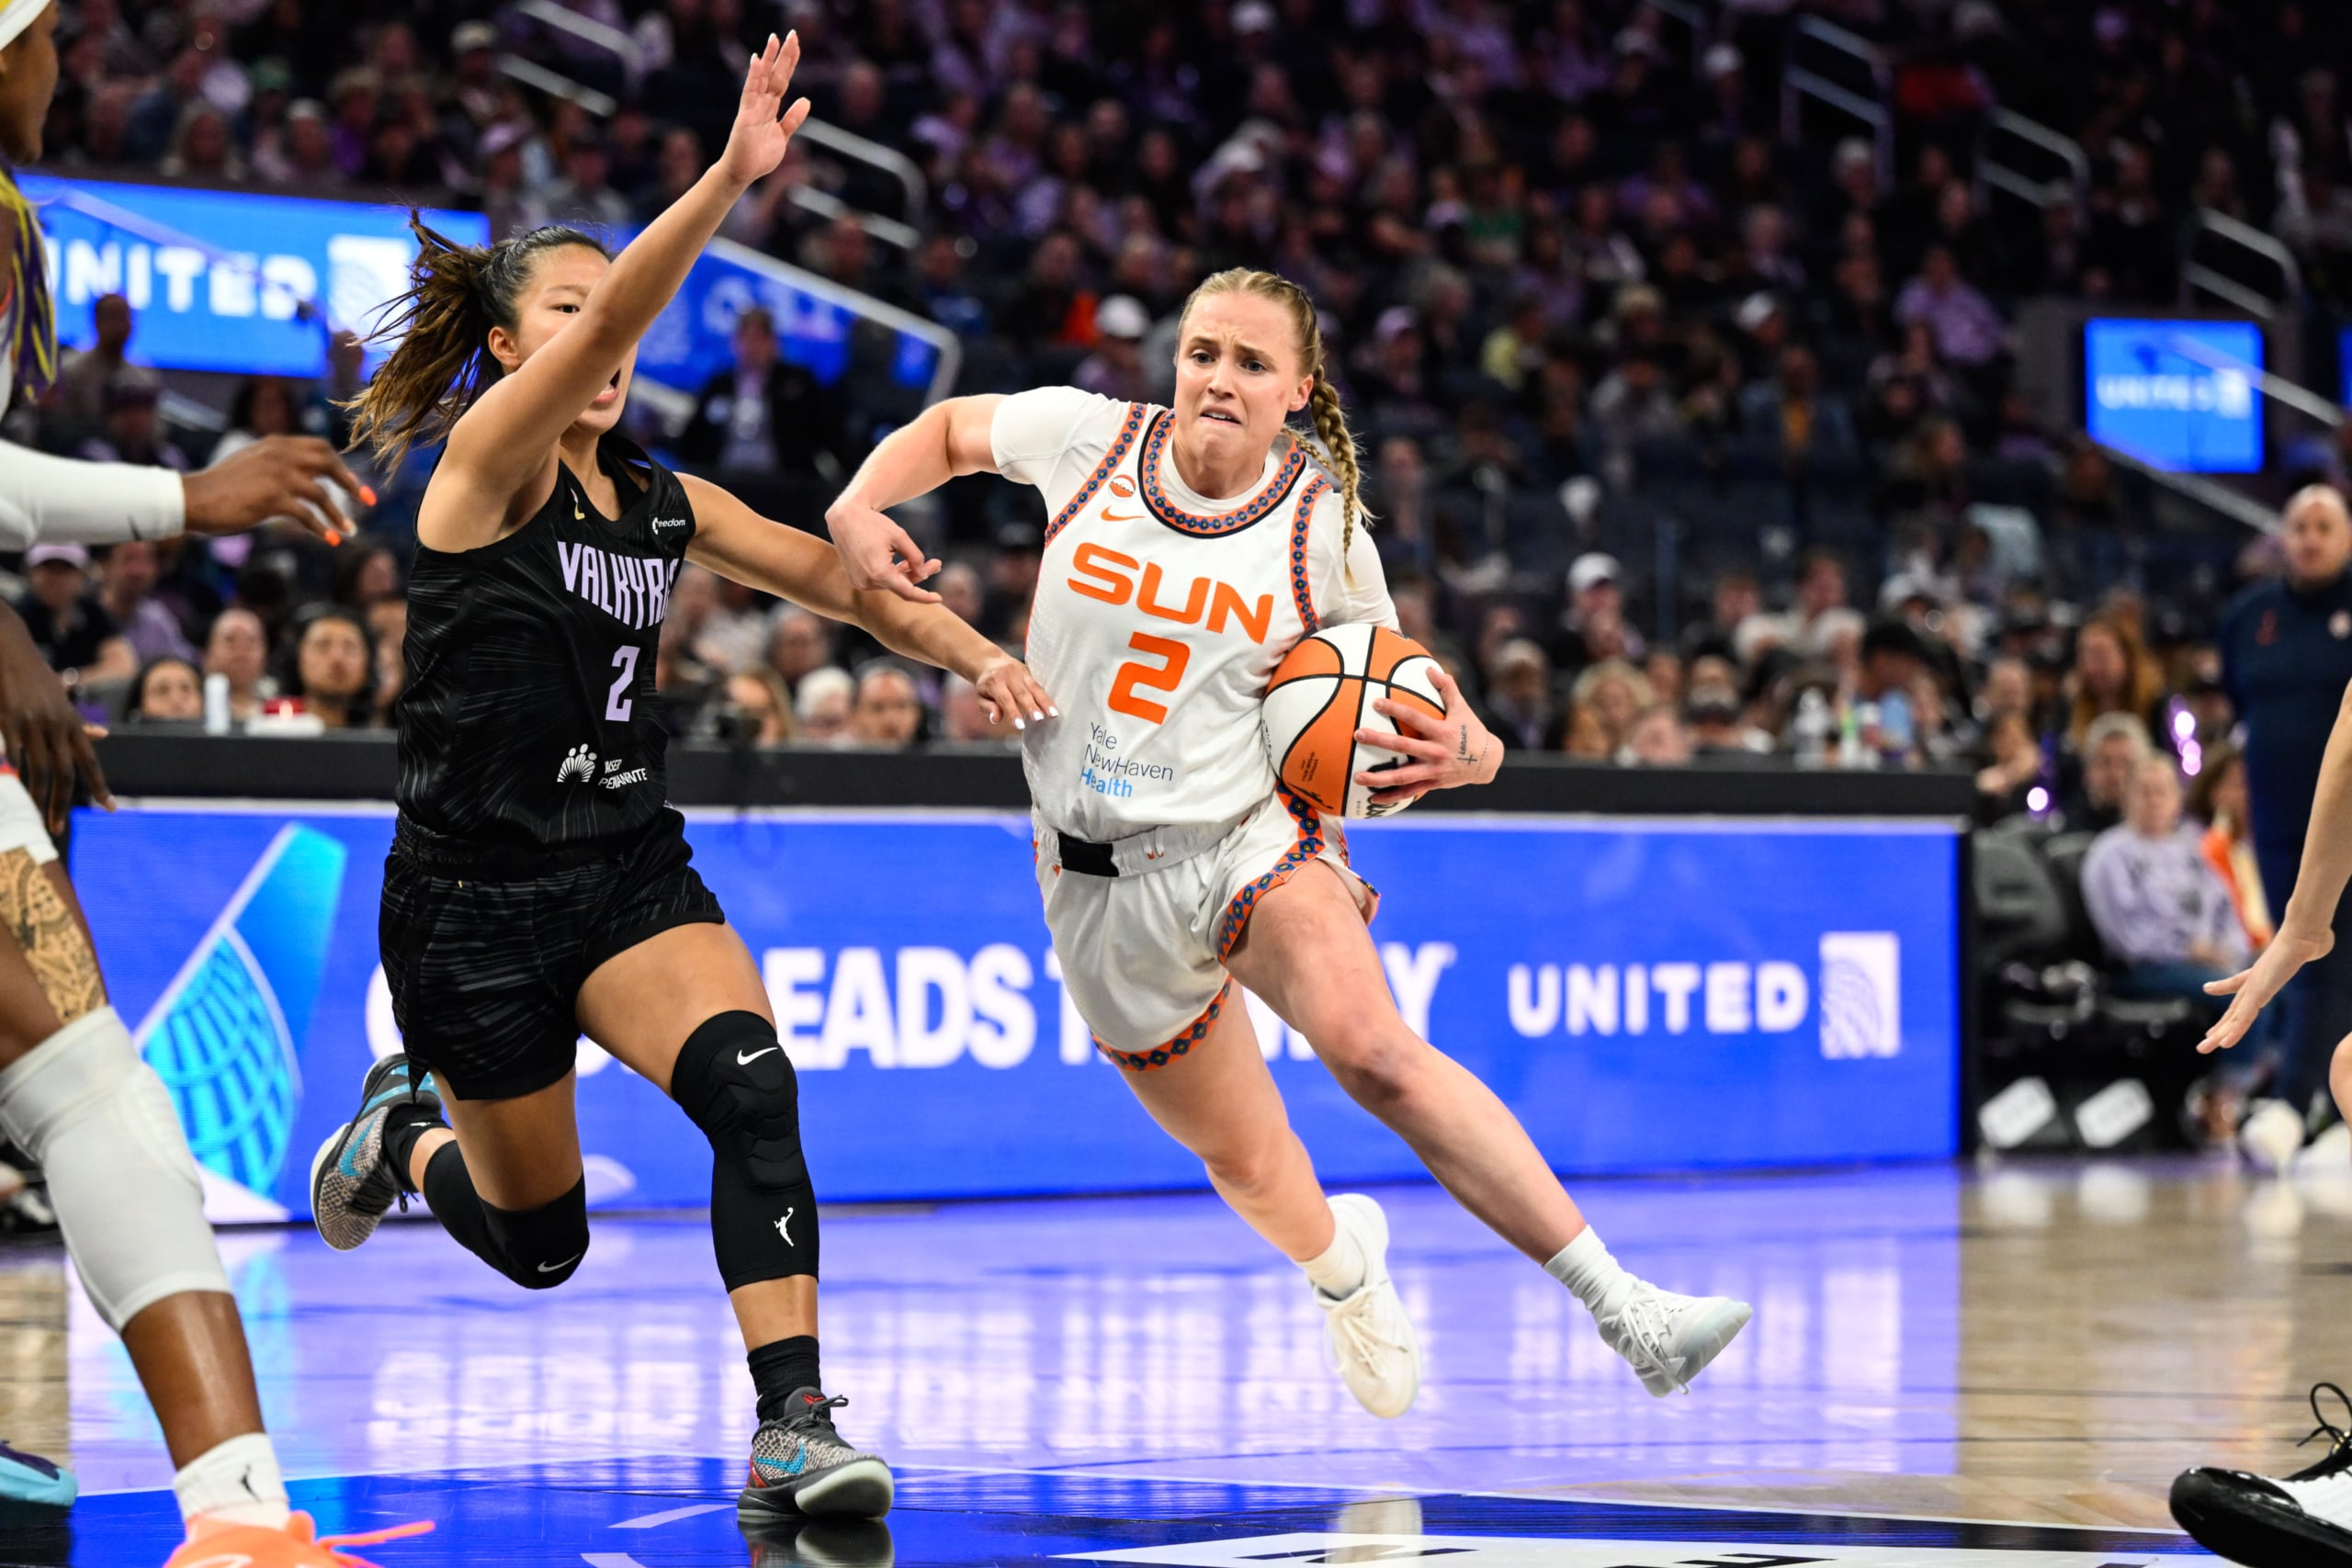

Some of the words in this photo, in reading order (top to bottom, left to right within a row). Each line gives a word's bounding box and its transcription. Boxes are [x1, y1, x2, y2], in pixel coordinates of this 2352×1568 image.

[1068, 542, 1274, 645] SUN
[605, 645, 640, 722] 2
[1108, 631, 1191, 726] 2
[1084, 743, 1174, 782] NewHaven
[1091, 721, 1117, 750] Yale
[1079, 766, 1133, 798] Health
[763, 942, 1037, 1070] EADS
[1508, 961, 1810, 1038] UNITED
